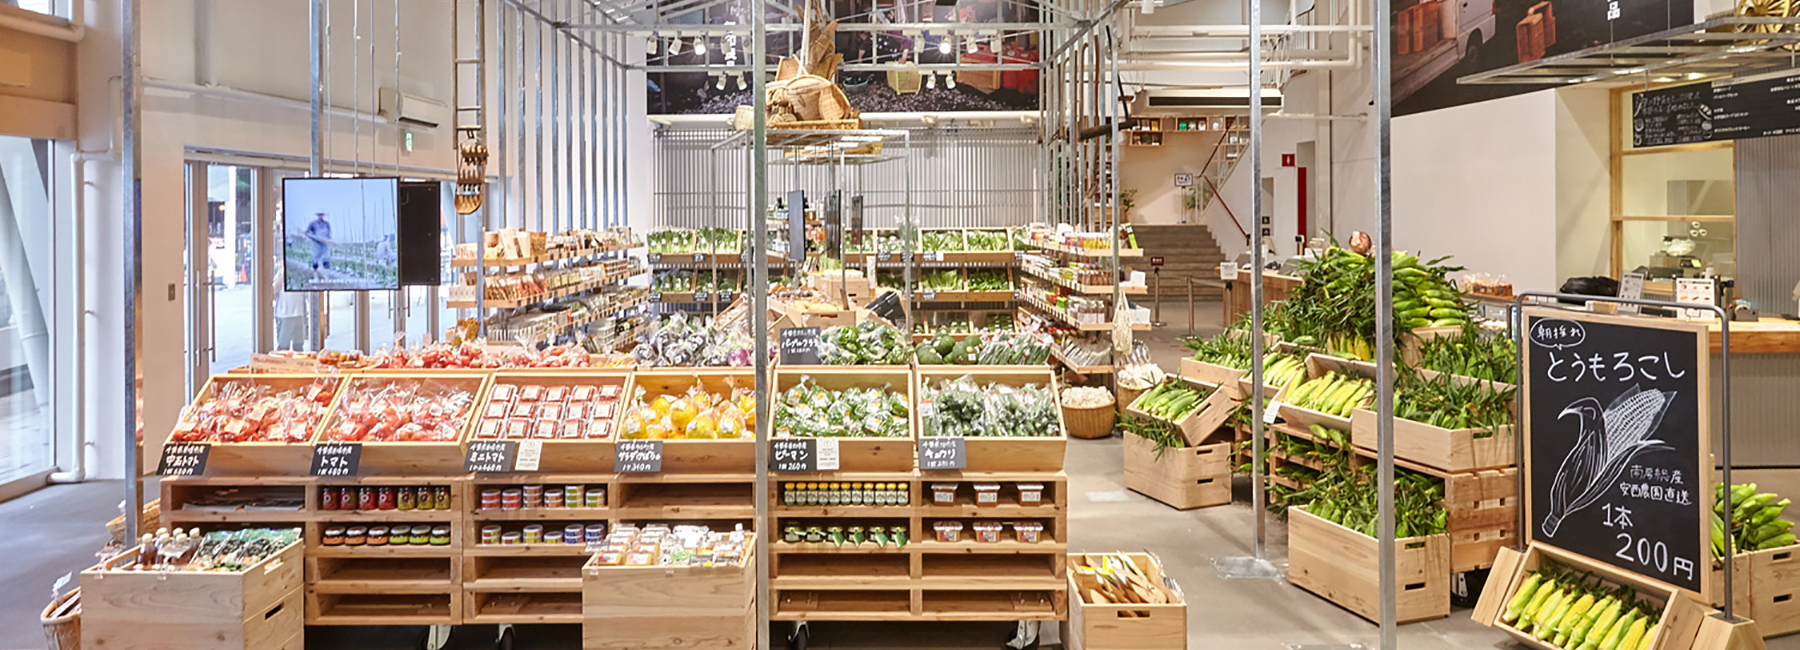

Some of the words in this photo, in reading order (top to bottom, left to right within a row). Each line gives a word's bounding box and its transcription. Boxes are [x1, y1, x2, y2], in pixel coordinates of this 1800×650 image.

[1536, 323, 1581, 341] 朝採れ
[1547, 351, 1685, 382] とうもろこし
[165, 454, 200, 467] 中玉トマト
[320, 456, 348, 467] トマト
[469, 451, 505, 463] ミニトマト
[775, 450, 808, 461] ピーマン
[1620, 481, 1692, 506] 安西農園直送
[1602, 503, 1633, 529] 1本
[1615, 533, 1694, 581] 200円
